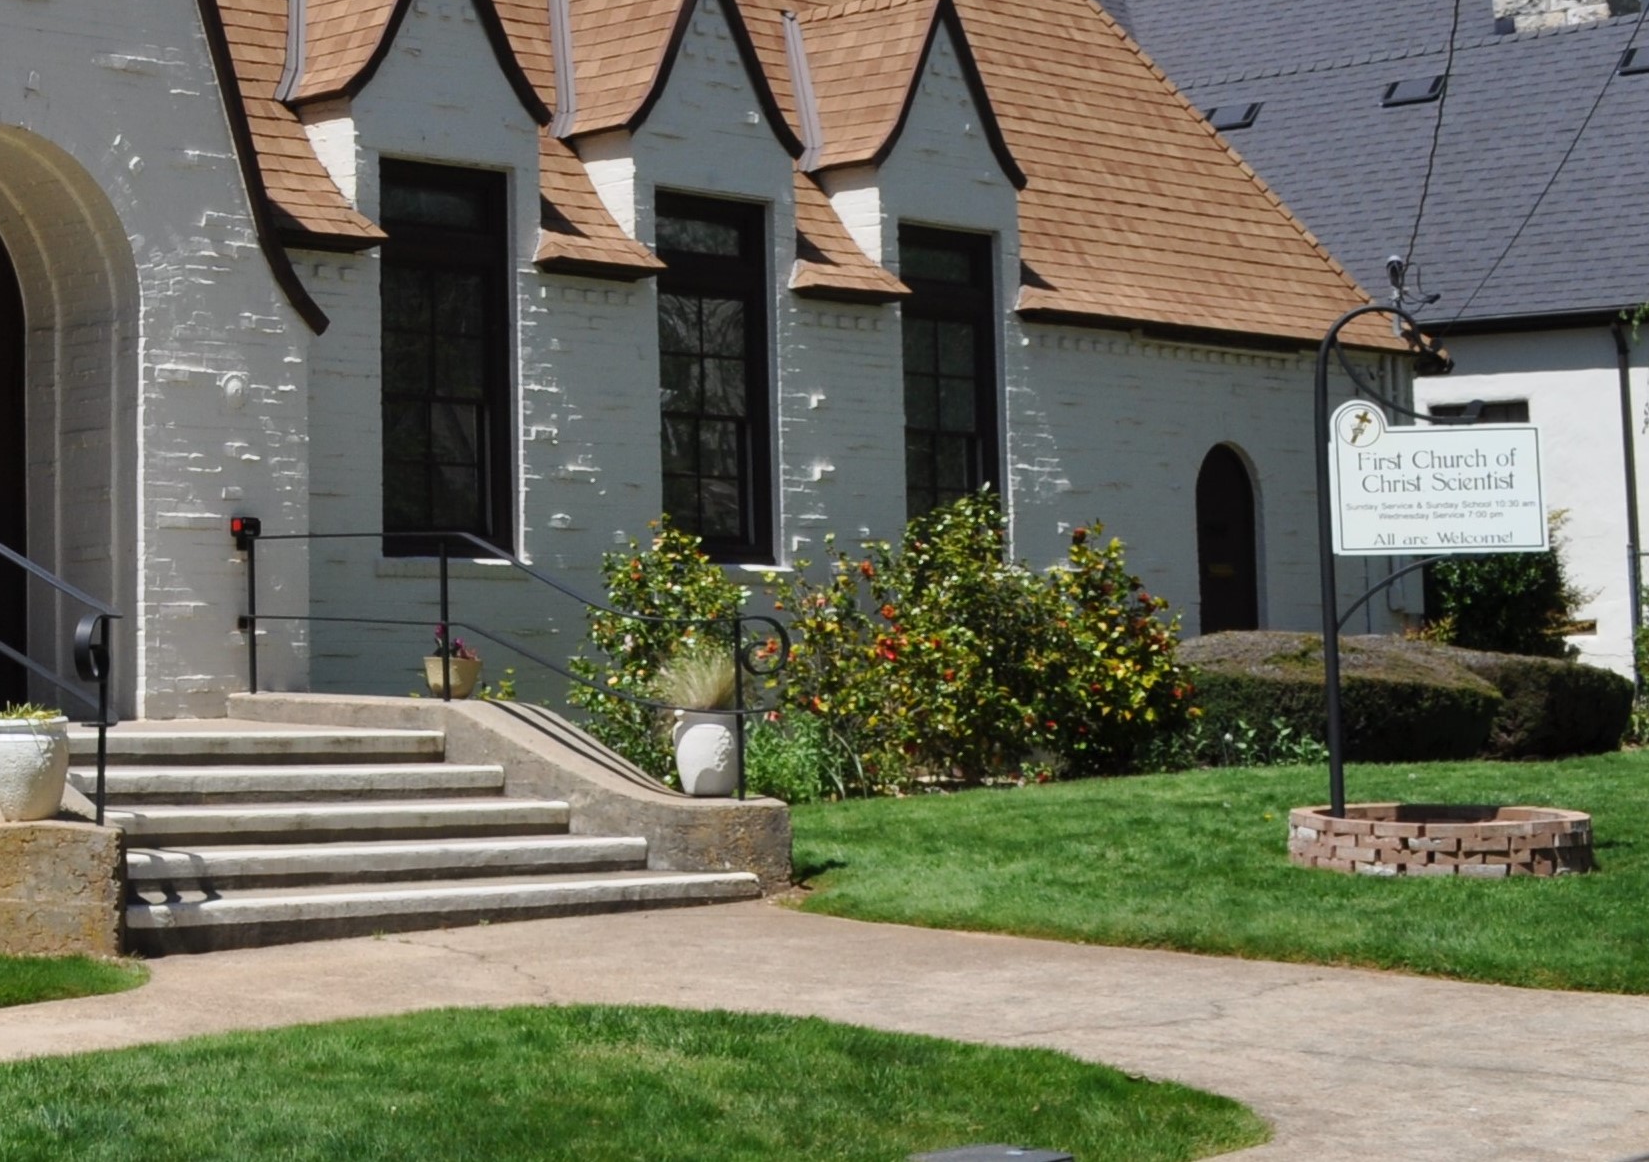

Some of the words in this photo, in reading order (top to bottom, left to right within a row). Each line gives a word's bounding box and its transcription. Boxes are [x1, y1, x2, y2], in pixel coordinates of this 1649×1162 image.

[1357, 451, 1402, 471] First
[1412, 448, 1487, 469] Church
[1495, 447, 1517, 467] of
[1361, 473, 1422, 493] Christ
[1431, 470, 1515, 492] Scientist
[1345, 502, 1378, 511] Sunday
[1381, 501, 1414, 510] Service
[1425, 500, 1459, 510] Sunday
[1461, 499, 1493, 509] School
[1378, 511, 1430, 521] Wednesday
[1432, 510, 1465, 519] Service
[1373, 533, 1395, 546] All
[1402, 535, 1429, 546] are
[1436, 530, 1514, 546] Welcome!
